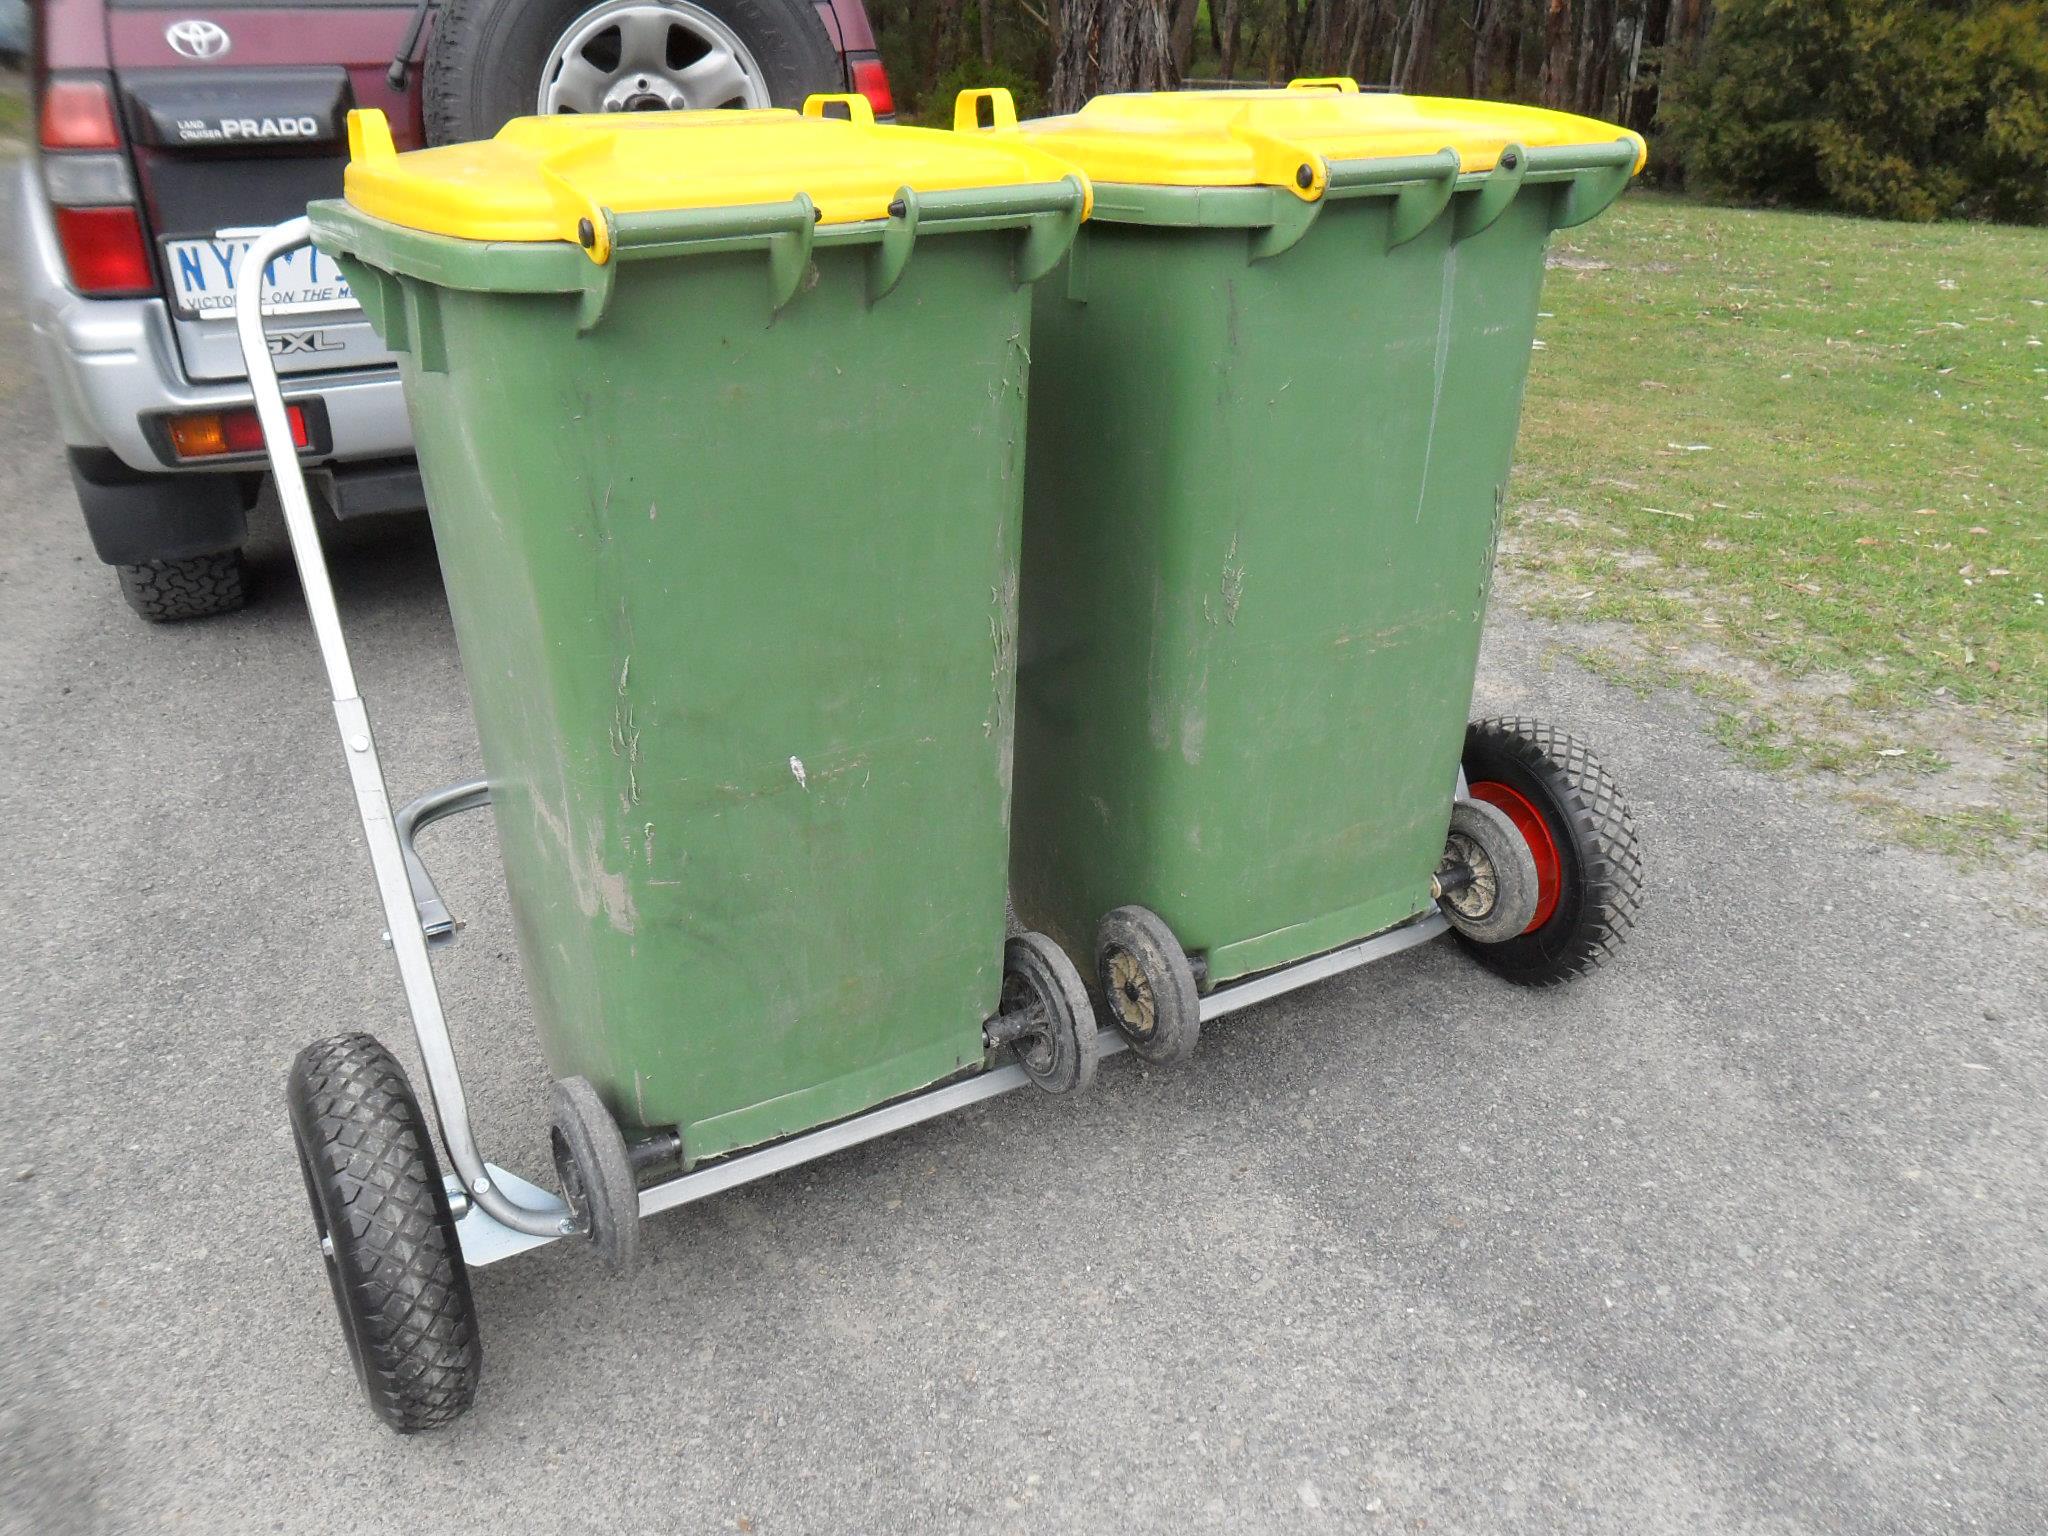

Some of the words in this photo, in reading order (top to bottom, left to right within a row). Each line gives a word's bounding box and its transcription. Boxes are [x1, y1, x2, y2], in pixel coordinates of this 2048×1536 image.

[177, 120, 204, 129] LAND
[220, 117, 318, 138] PRADO
[180, 129, 222, 140] CRUISER
[187, 295, 238, 309] VICTO
[272, 290, 296, 304] ON
[302, 287, 334, 302] THE
